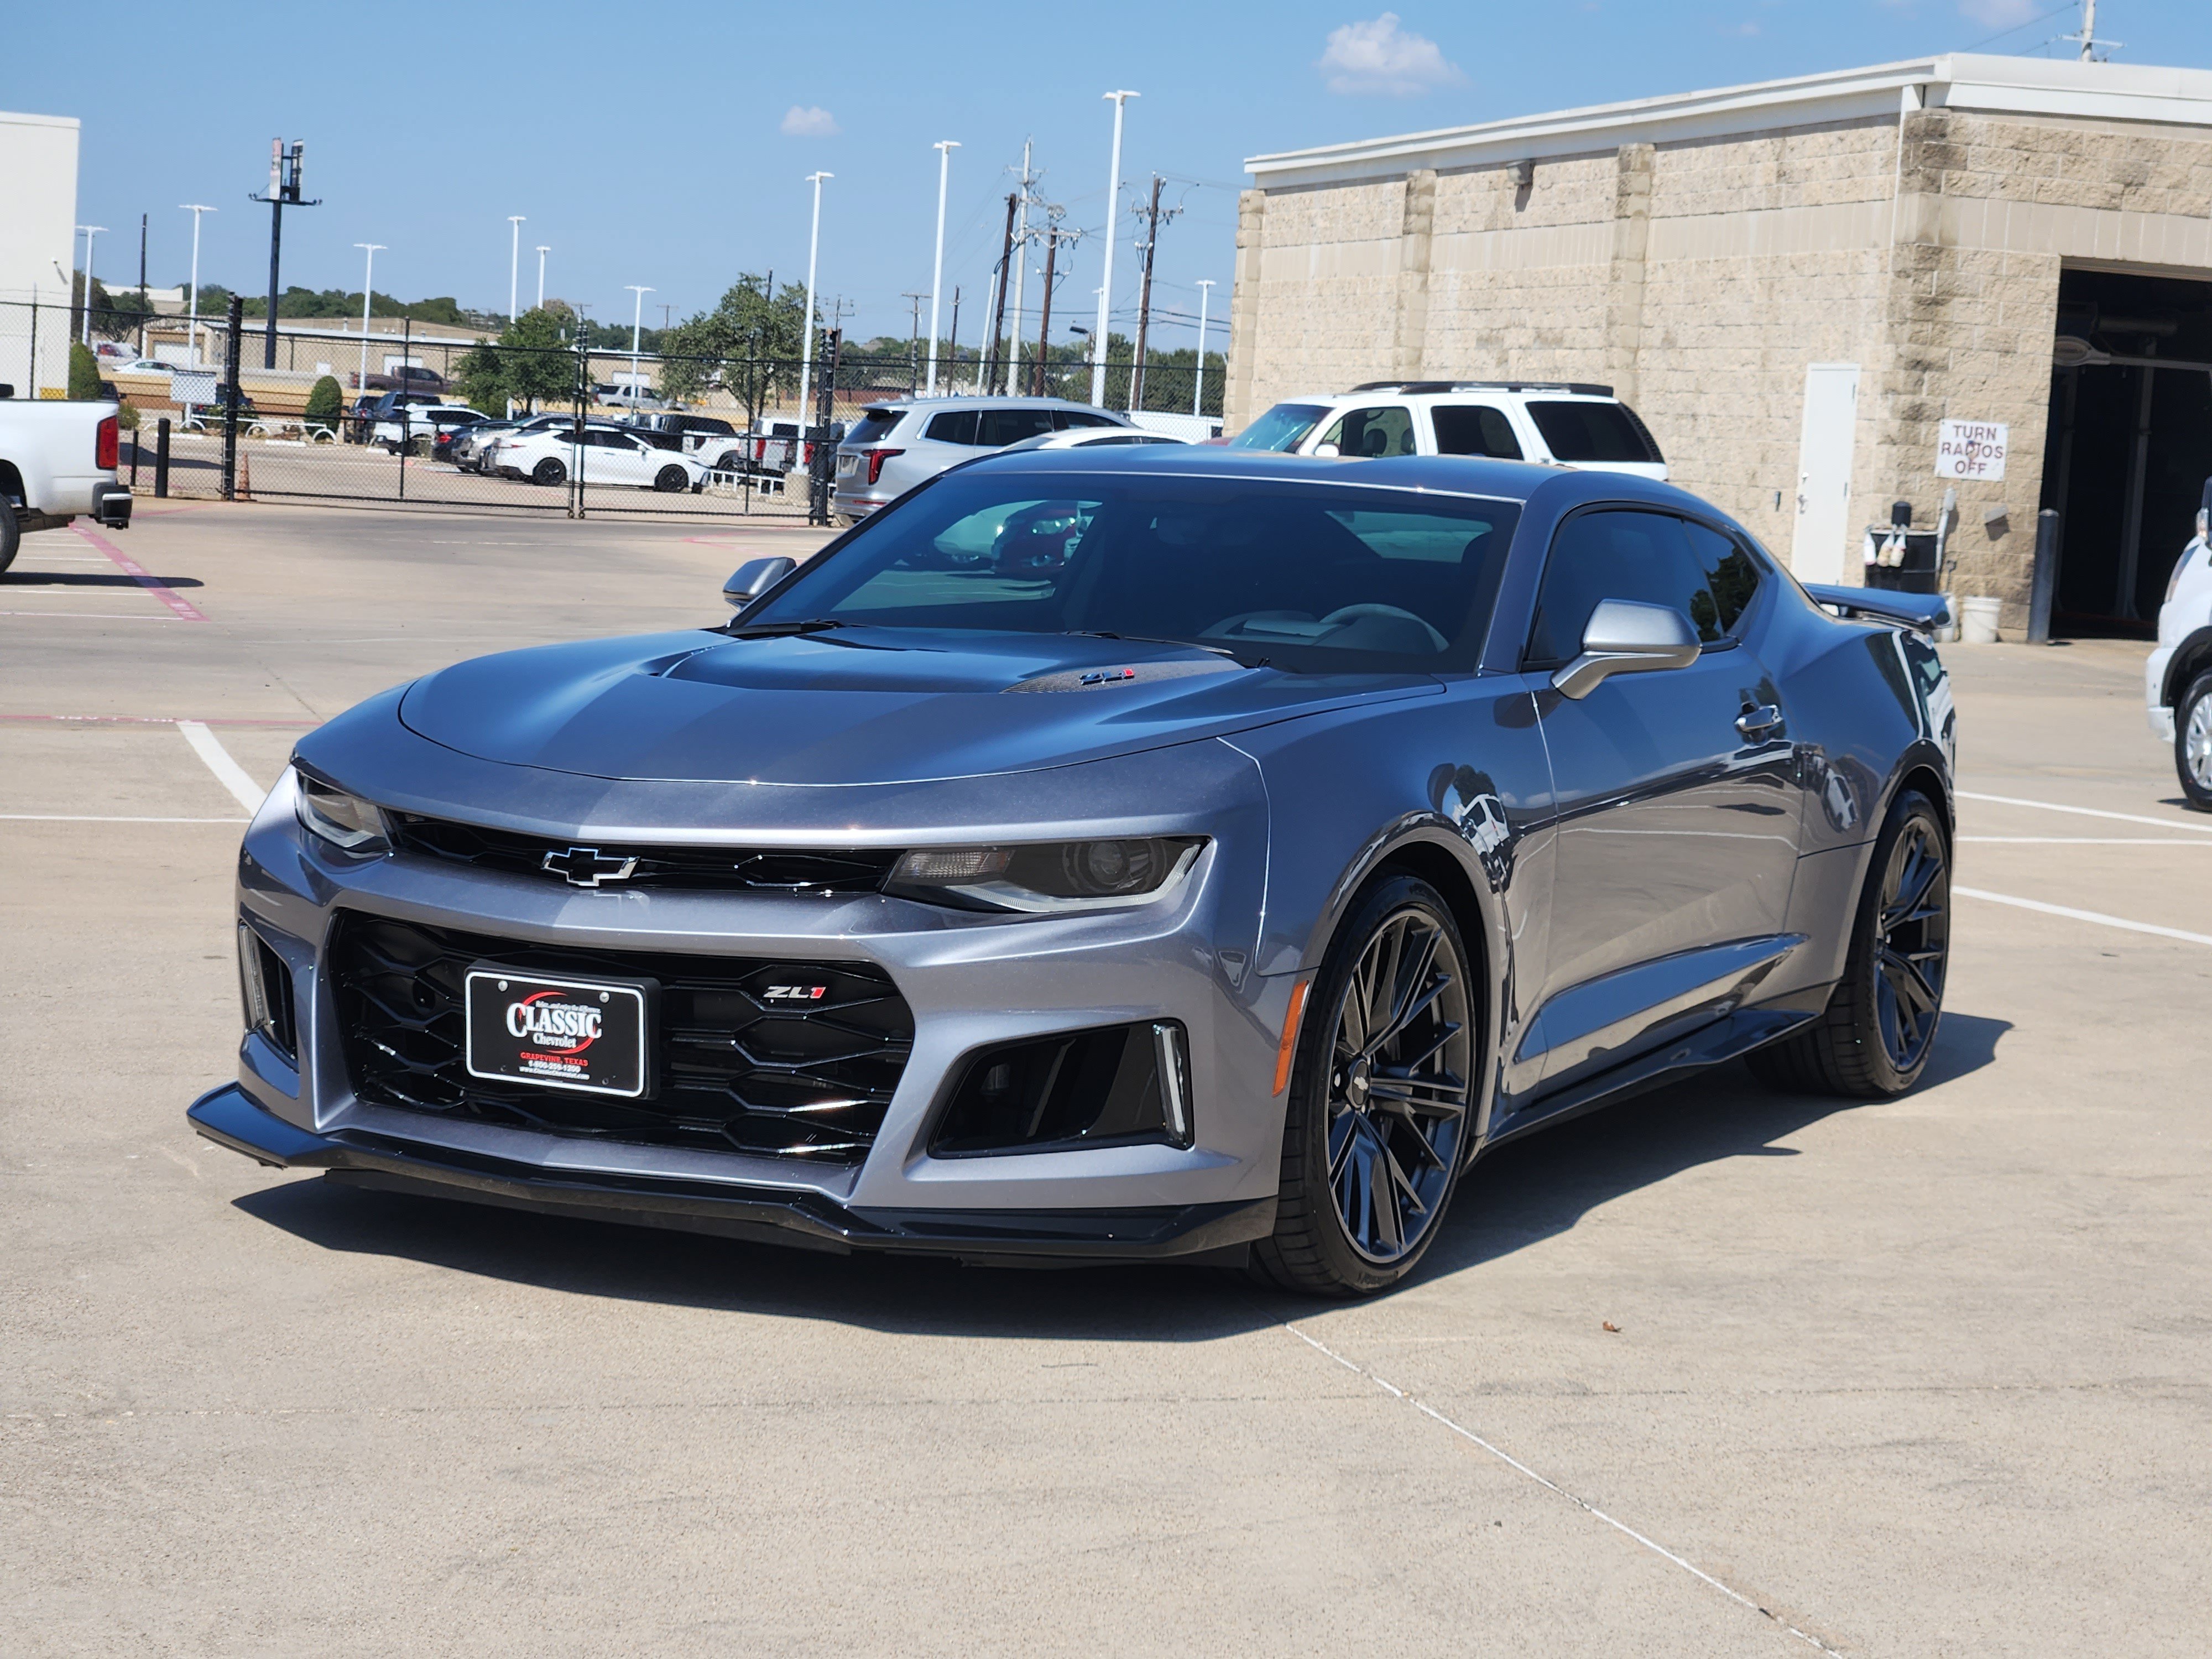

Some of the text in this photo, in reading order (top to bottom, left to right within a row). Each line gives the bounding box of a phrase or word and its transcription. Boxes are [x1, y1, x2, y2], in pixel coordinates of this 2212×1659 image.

[1953, 425, 1997, 441] TURN
[1941, 442, 2003, 459] RADIOS
[1955, 461, 1987, 474] OFF
[763, 986, 826, 999] ZL1
[507, 1003, 602, 1039] CLASSIC
[533, 1032, 577, 1048] Chevrolet
[520, 1052, 563, 1064] GRAPEVINE,
[564, 1057, 588, 1067] TEXAS
